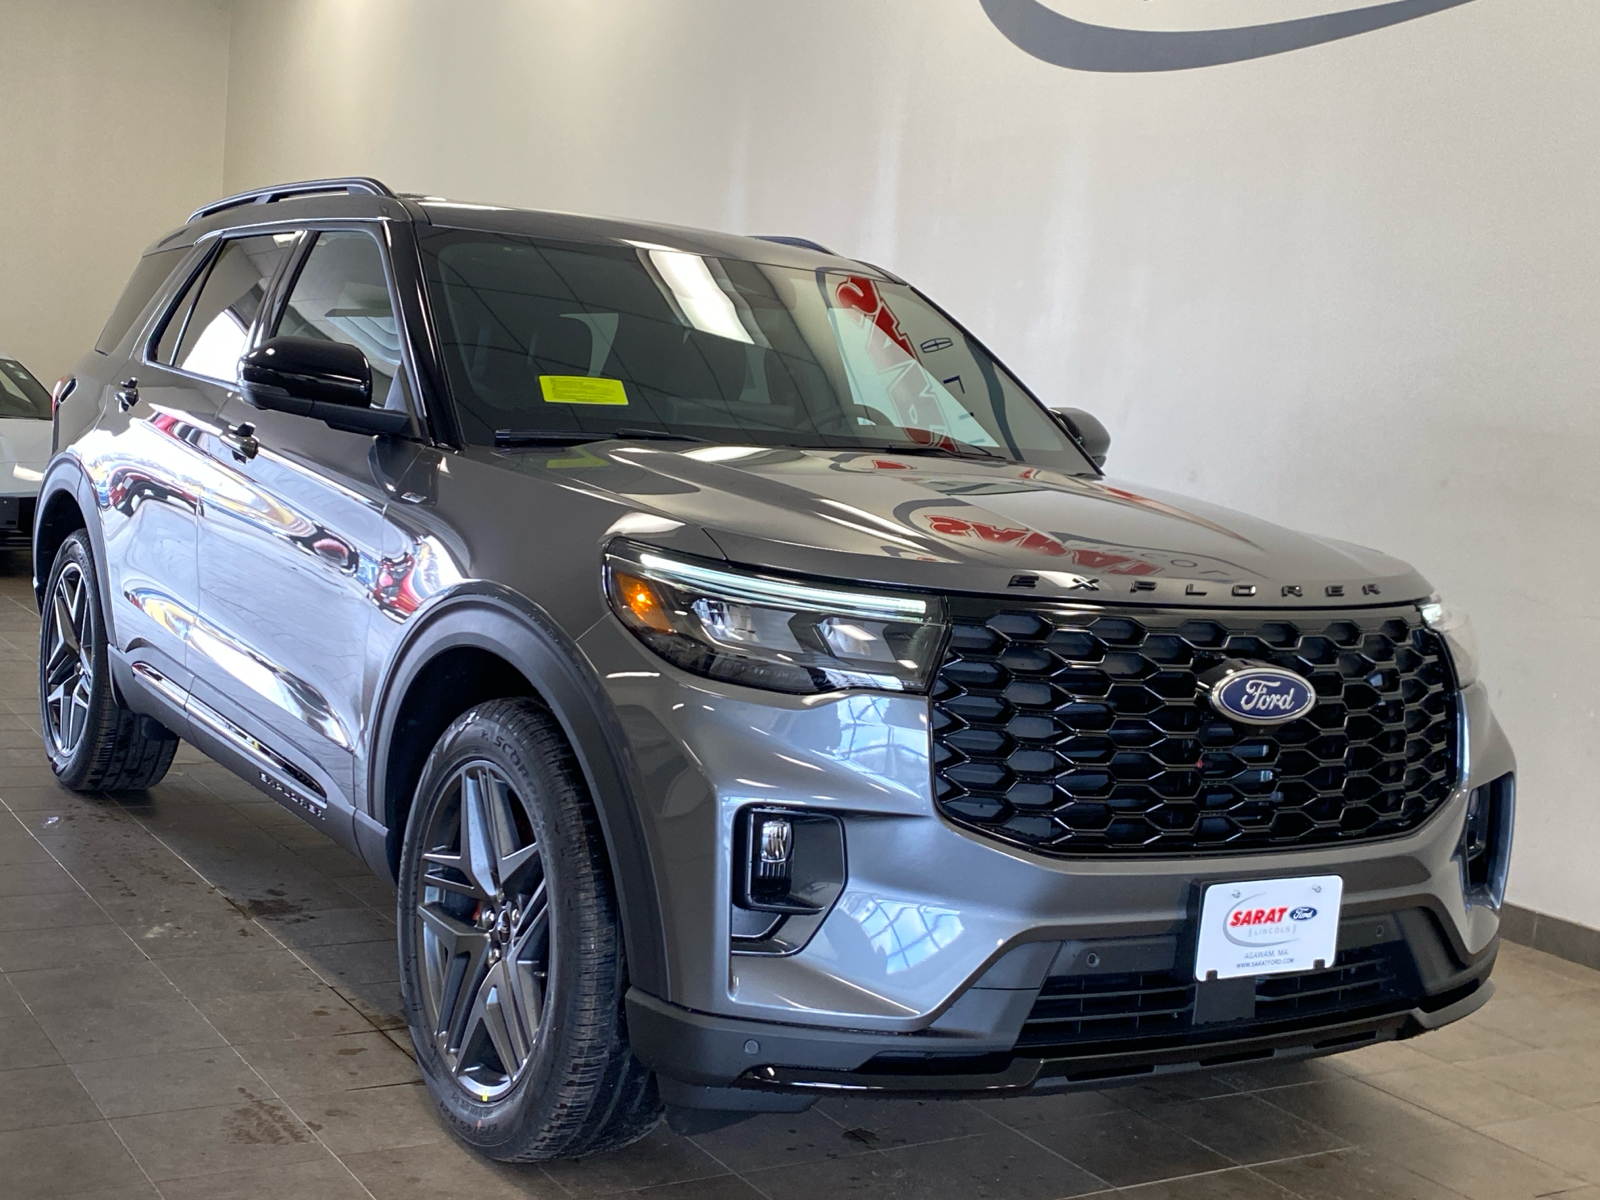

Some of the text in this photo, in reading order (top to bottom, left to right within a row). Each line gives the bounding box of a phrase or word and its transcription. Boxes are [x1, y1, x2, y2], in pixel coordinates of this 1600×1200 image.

[1008, 574, 1382, 597] EXPLORER
[1241, 680, 1295, 710] Ford
[1230, 906, 1314, 927] SARAT Ford
[1254, 926, 1291, 937] LINCOLN
[1278, 949, 1288, 957] MA
